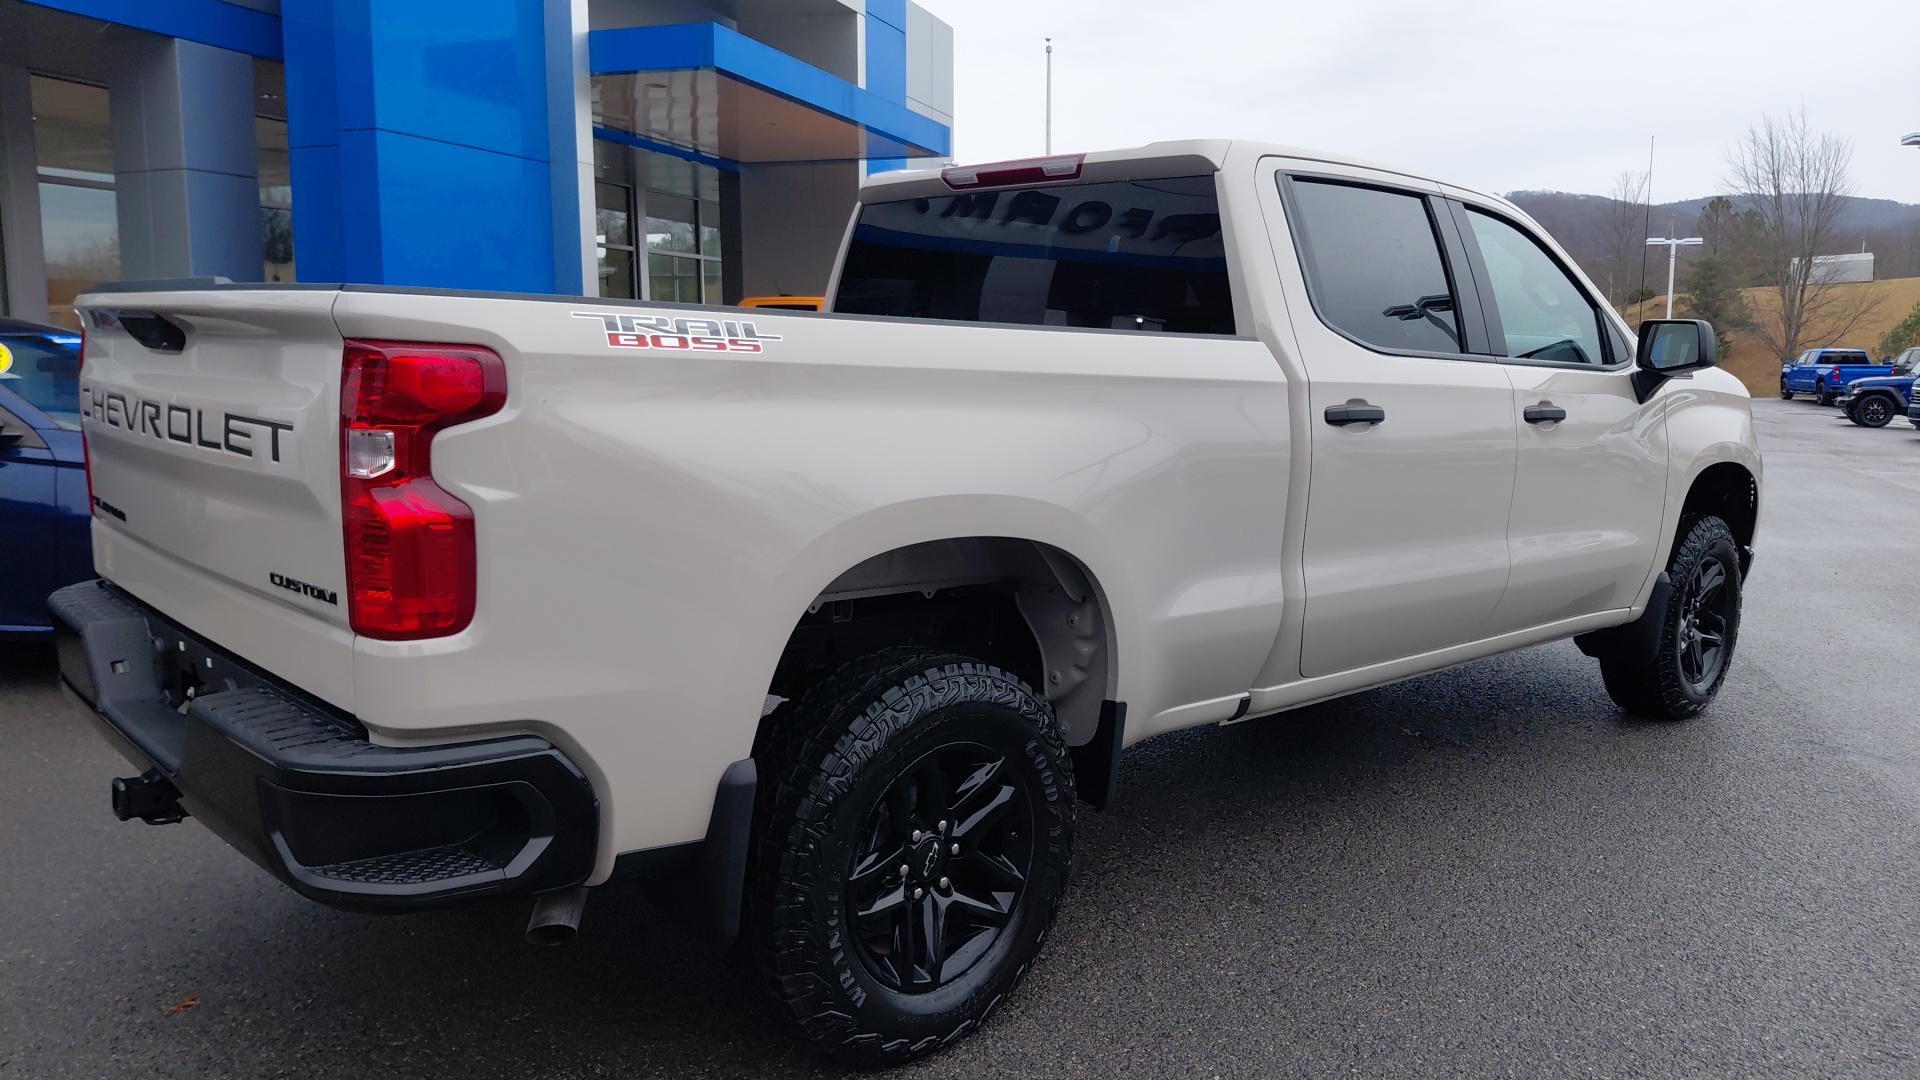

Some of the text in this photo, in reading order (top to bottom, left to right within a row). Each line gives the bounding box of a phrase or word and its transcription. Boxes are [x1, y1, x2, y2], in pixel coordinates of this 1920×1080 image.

[570, 311, 784, 341] TRAIL
[606, 332, 764, 354] BOSS
[82, 388, 294, 463] CHEVROLET
[269, 571, 338, 606] CUSTOM
